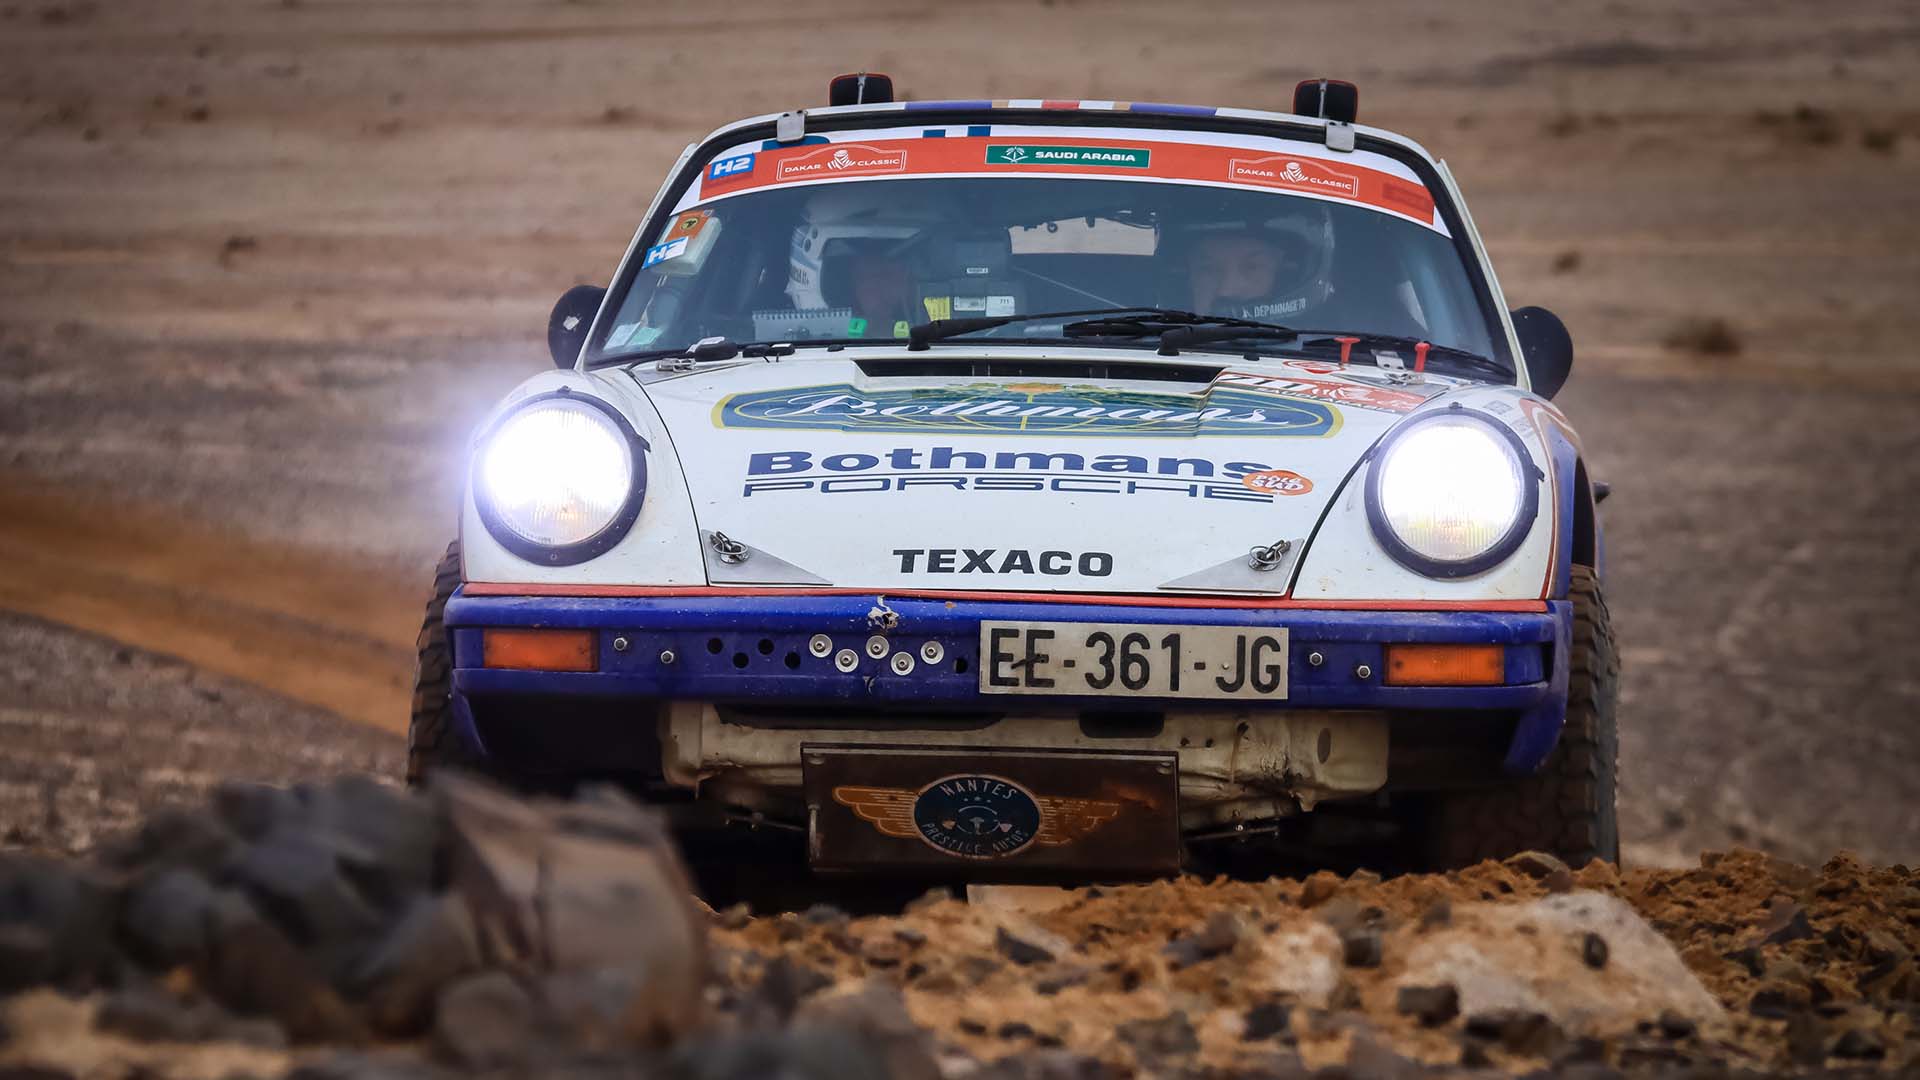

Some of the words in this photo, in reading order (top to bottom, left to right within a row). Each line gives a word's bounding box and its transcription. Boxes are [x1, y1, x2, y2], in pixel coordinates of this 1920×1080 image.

[713, 158, 751, 176] H2
[784, 164, 821, 173] DAKAR
[856, 158, 900, 167] CLASSIC
[1034, 151, 1078, 159] SAUDI
[1081, 152, 1136, 162] ARABIA
[1236, 168, 1275, 177] DAKAR
[1309, 177, 1353, 190] CLASSIC
[647, 240, 686, 264] H2
[747, 446, 1273, 480] Bothmans
[743, 476, 1273, 504] PORSCHE
[893, 549, 1114, 578] TEXACO
[989, 627, 1281, 694] EE-361-JG
[940, 779, 1017, 800] NANTES
